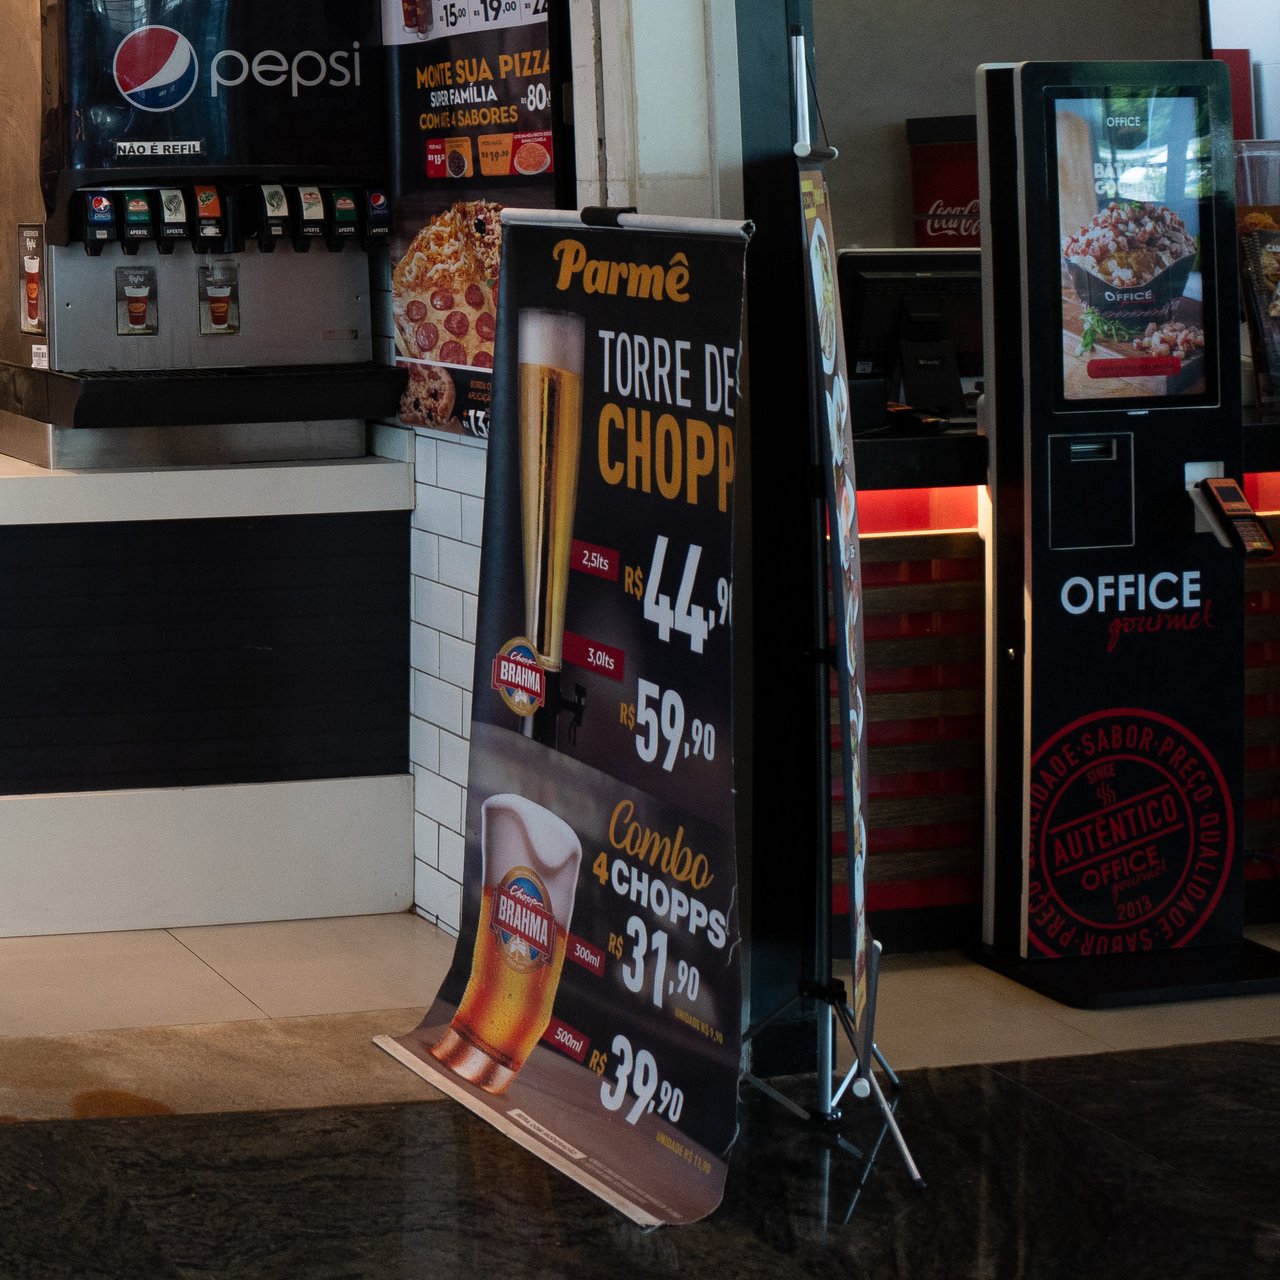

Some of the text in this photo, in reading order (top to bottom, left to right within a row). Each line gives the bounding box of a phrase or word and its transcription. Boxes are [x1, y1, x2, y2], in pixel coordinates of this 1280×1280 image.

[211, 41, 361, 98] pepsi
[416, 48, 550, 89] MONTE SUA PIZZA
[431, 83, 498, 107] SUPER FAMÍLIA
[458, 105, 518, 127] SABORES
[1106, 117, 1140, 127] OFFICE
[117, 141, 200, 155] NÃO É REFIL
[552, 238, 690, 303] Parmê
[1104, 290, 1152, 301] OFFICE
[598, 329, 736, 418] TORRE DE
[597, 402, 735, 514] CHOPP
[582, 549, 609, 572] 2,5lts
[624, 535, 733, 655] R$ 44,9
[1060, 570, 1201, 615] OFFICE
[1107, 600, 1216, 653] gourmet
[500, 661, 540, 694] BRAHMA
[587, 647, 614, 670] 3,0lts
[620, 677, 716, 773] R$ 59,90
[1086, 763, 1116, 784] SINCE
[608, 799, 714, 891] Combo
[1053, 794, 1178, 867] AUTÊNTICO
[1080, 724, 1221, 940] SABOR PREÇO QUALIDADE
[1081, 844, 1159, 891] OFFICE
[510, 884, 543, 908] Chopp
[592, 851, 727, 949] 4 CHOPPS
[498, 894, 548, 947] BRAHMA
[574, 942, 601, 971] 300ml
[608, 915, 700, 1009] R$ 31,90
[555, 1027, 583, 1053] 500ml
[675, 1007, 700, 1030] UNIDADE
[589, 1034, 684, 1126] R$ 39,90
[656, 1131, 683, 1157] UNIDADE
